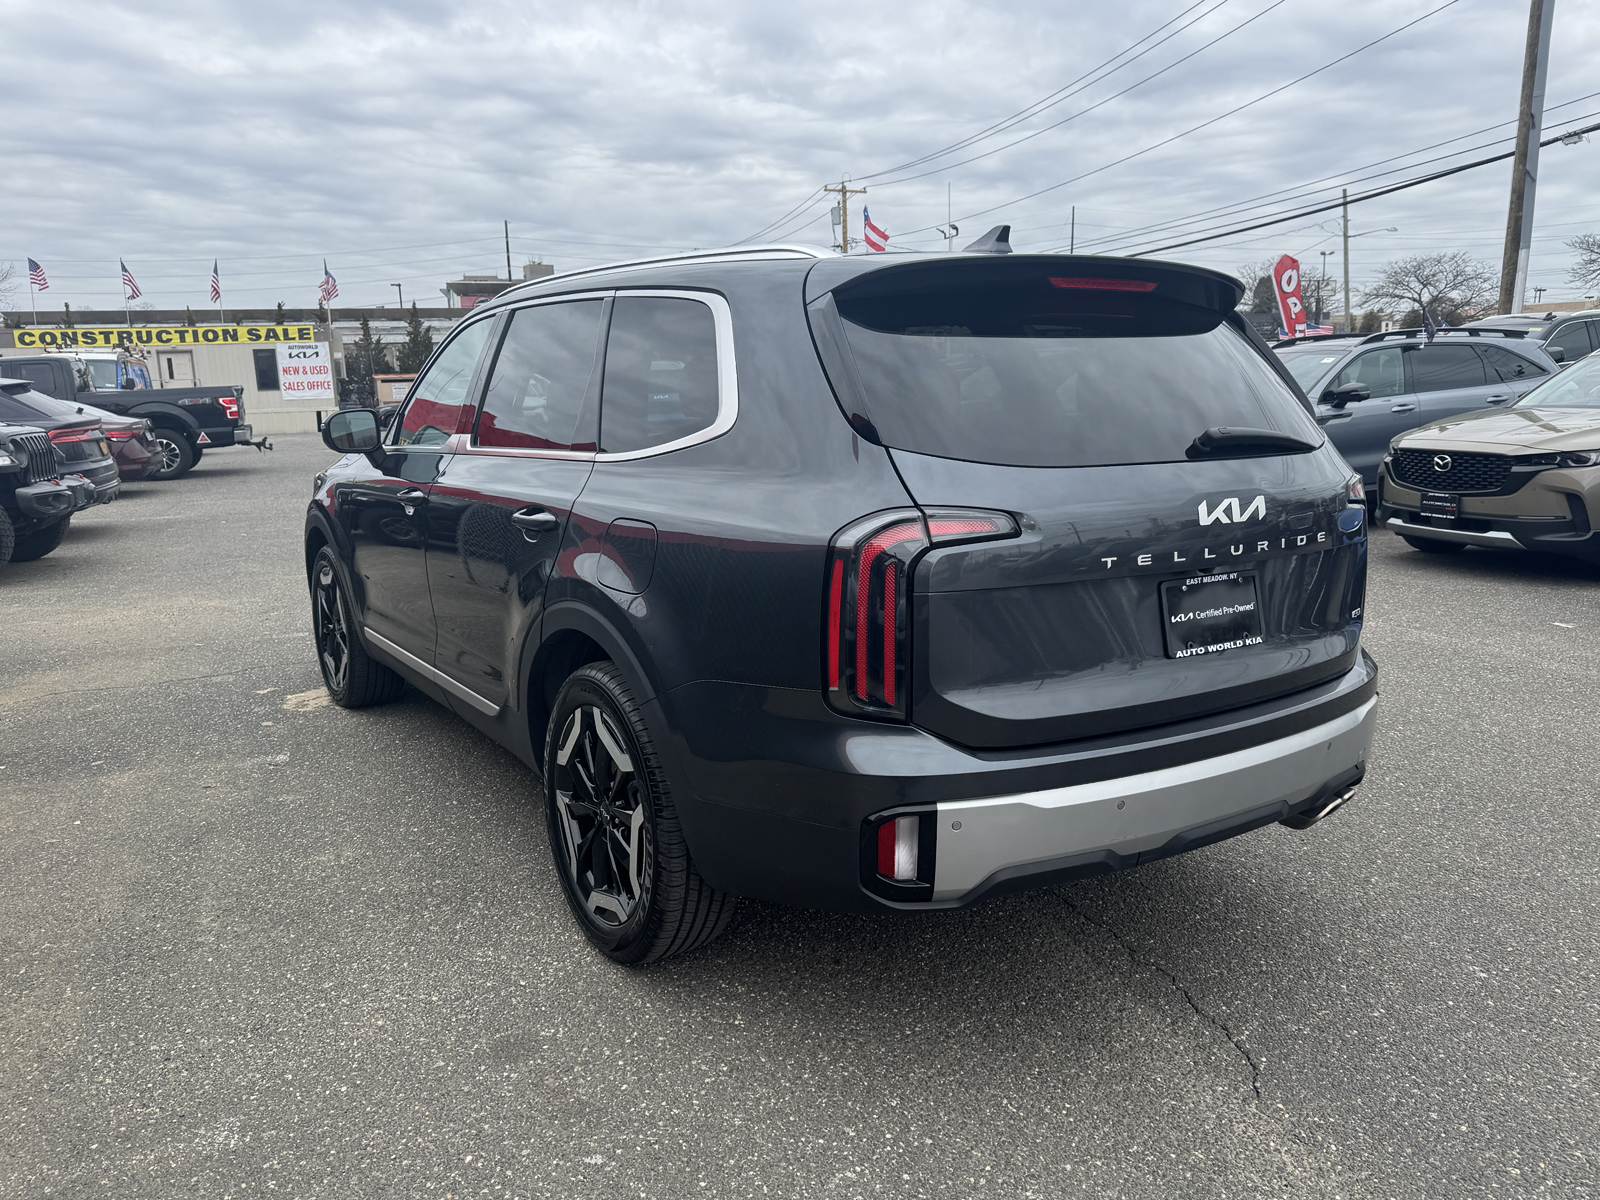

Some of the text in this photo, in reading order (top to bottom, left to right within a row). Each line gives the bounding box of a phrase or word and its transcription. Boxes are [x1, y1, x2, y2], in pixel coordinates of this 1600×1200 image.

[17, 327, 312, 347] CONSTRUCTION SALE
[288, 351, 319, 359] KIA
[282, 365, 329, 376] NEW & USED
[282, 381, 331, 391] SALES OFFICE
[1198, 495, 1267, 526] KIA
[1101, 531, 1326, 569] TELLURIDE
[1186, 577, 1202, 585] EAST
[1171, 612, 1194, 623] KIA
[1195, 608, 1223, 619] Certified
[1176, 636, 1263, 658] AUTO WORLD KIA
